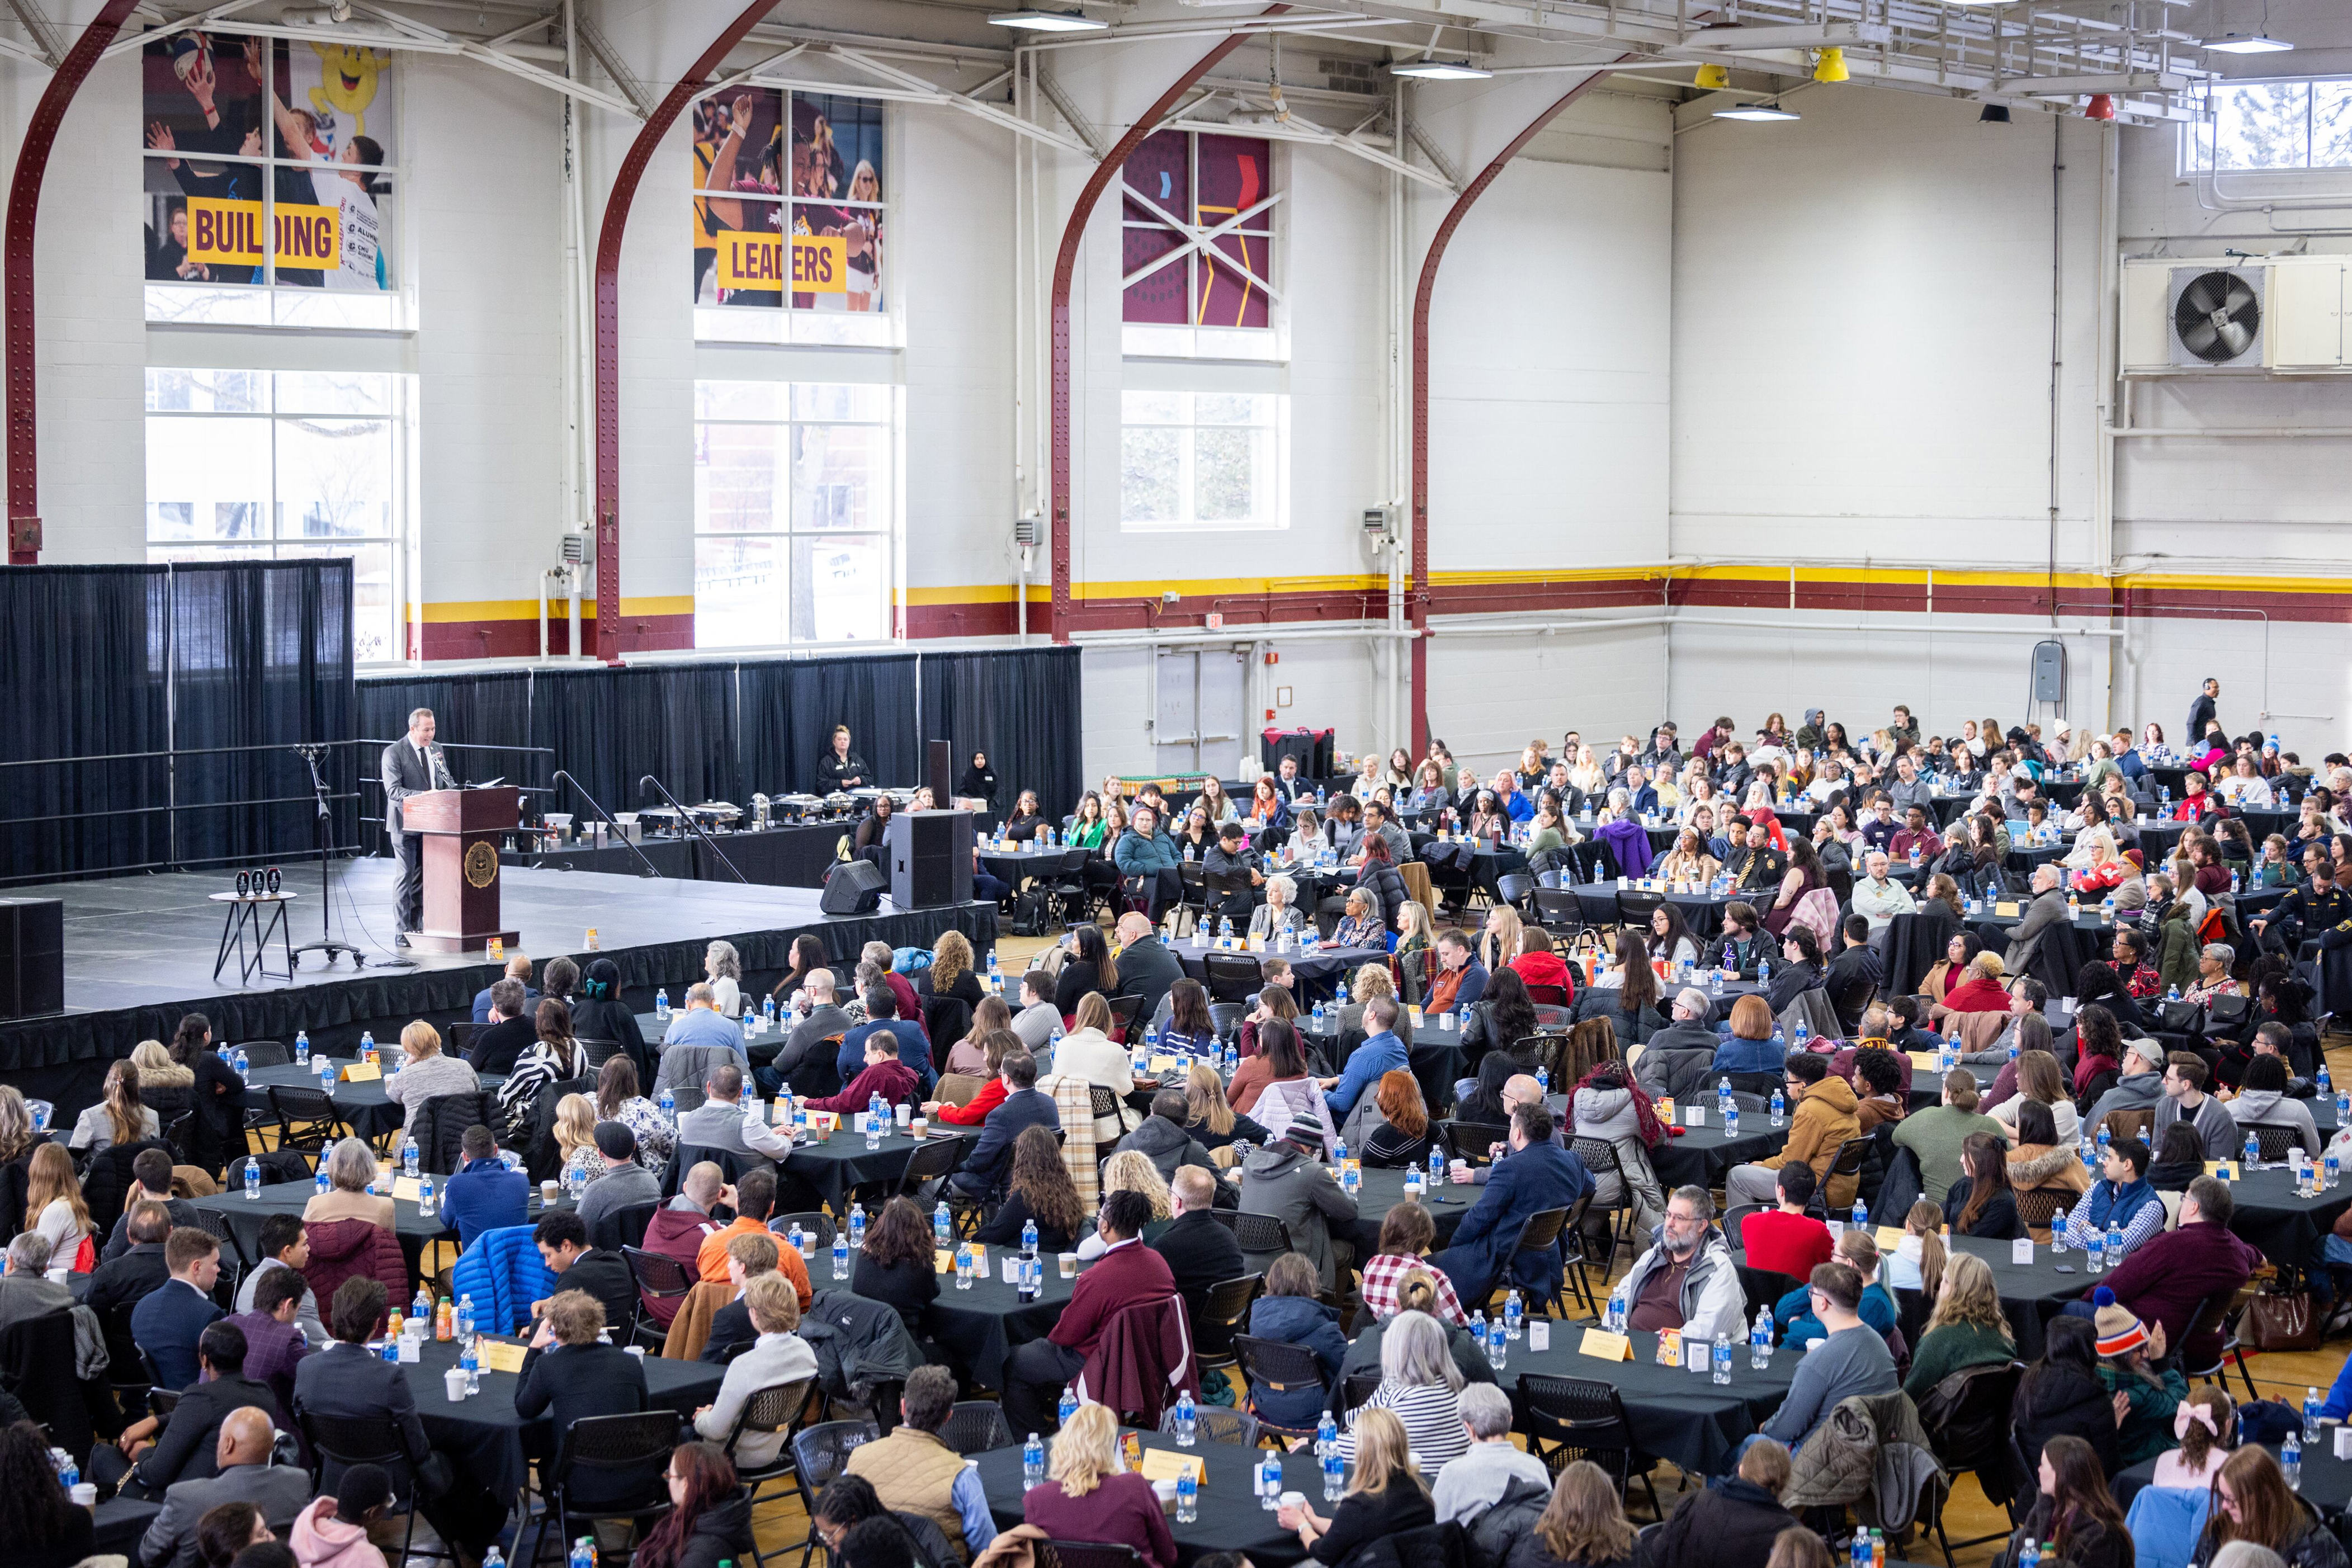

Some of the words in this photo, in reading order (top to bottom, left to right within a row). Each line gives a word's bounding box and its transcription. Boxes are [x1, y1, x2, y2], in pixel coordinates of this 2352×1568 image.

[358, 245, 369, 253] CMU
[1211, 616, 1221, 628] EXIT
[1534, 1334, 1545, 1344] 70
[403, 1346, 413, 1356] 75
[1695, 1355, 1705, 1364] 70
